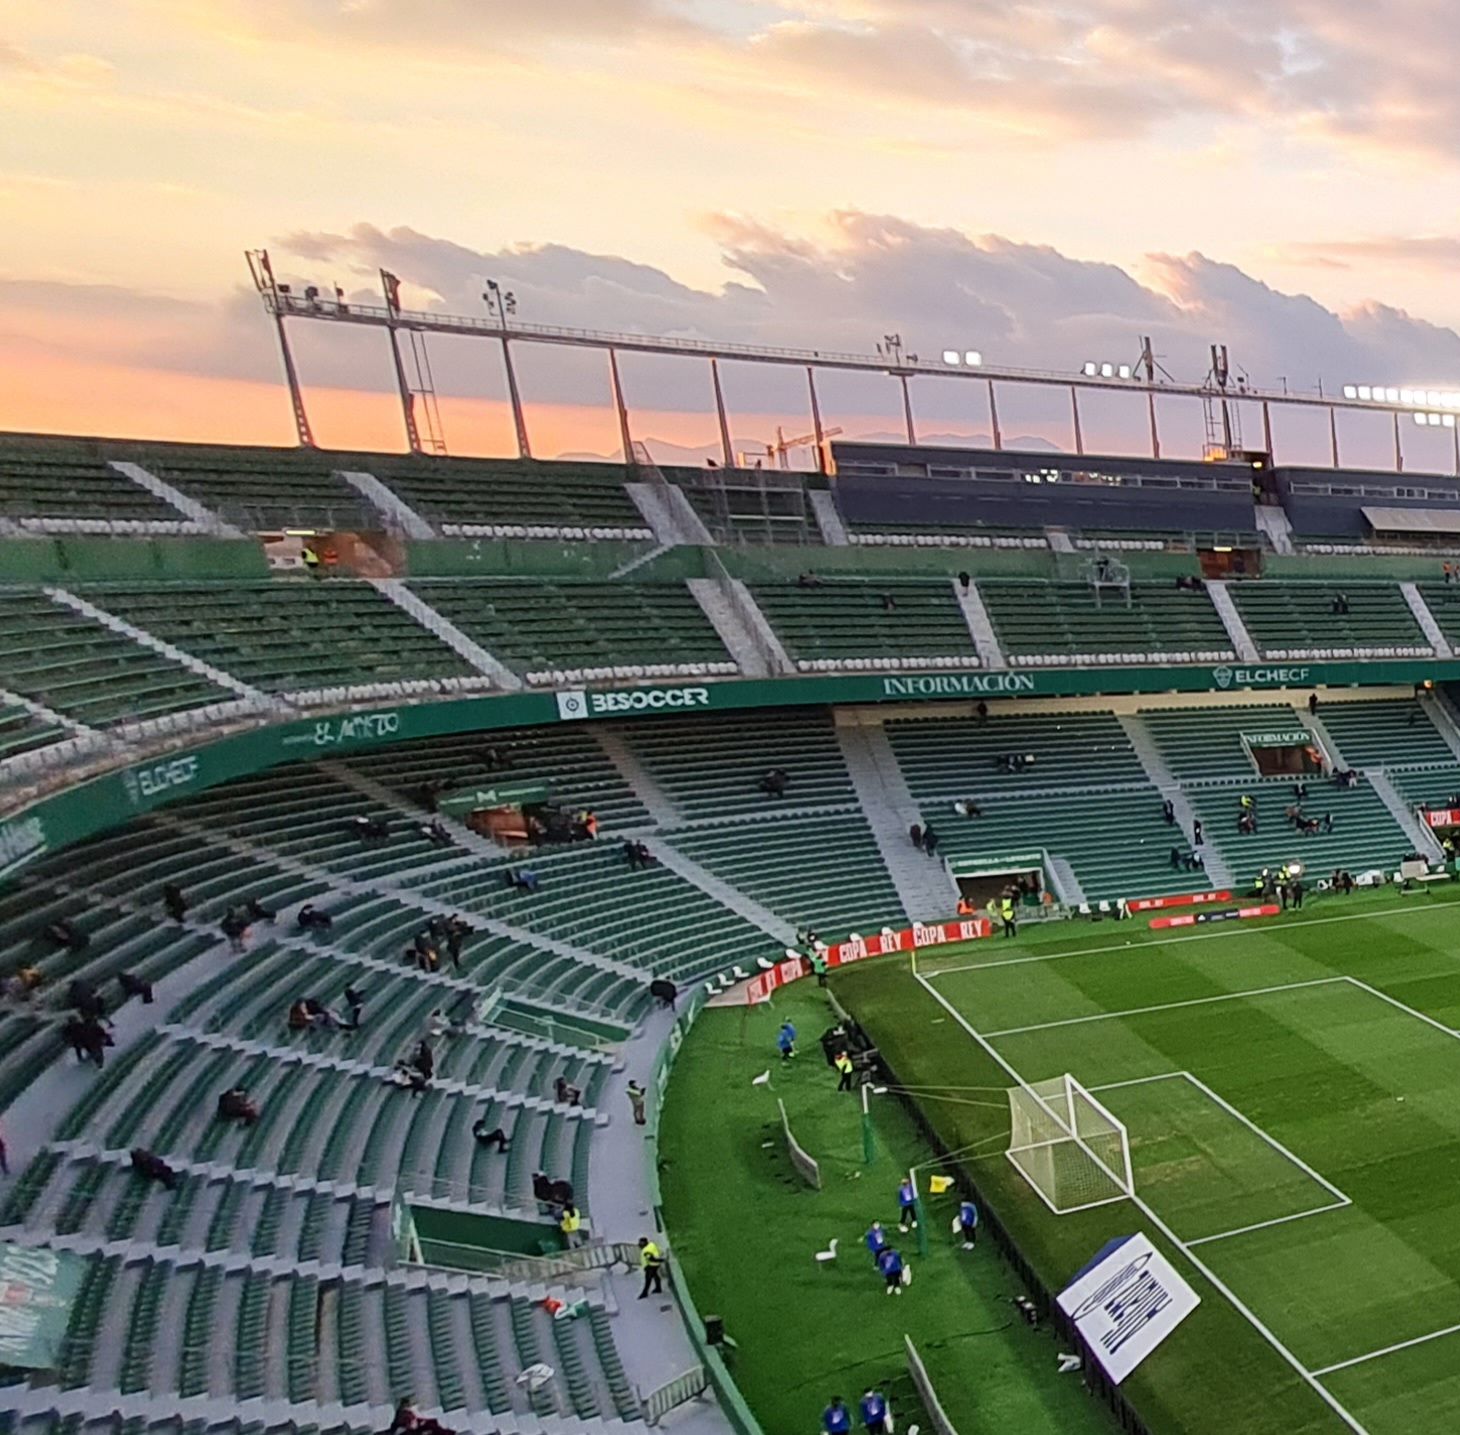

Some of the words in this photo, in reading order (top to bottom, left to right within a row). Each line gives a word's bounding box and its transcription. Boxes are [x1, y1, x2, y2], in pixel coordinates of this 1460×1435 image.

[883, 672, 1034, 695] INFORMACIÓN
[1235, 668, 1310, 683] ELCHECF
[591, 688, 709, 712] BESOCCER
[839, 939, 867, 963] COPA
[880, 931, 902, 952] REY
[913, 925, 946, 947] COPA
[960, 920, 983, 940] REY
